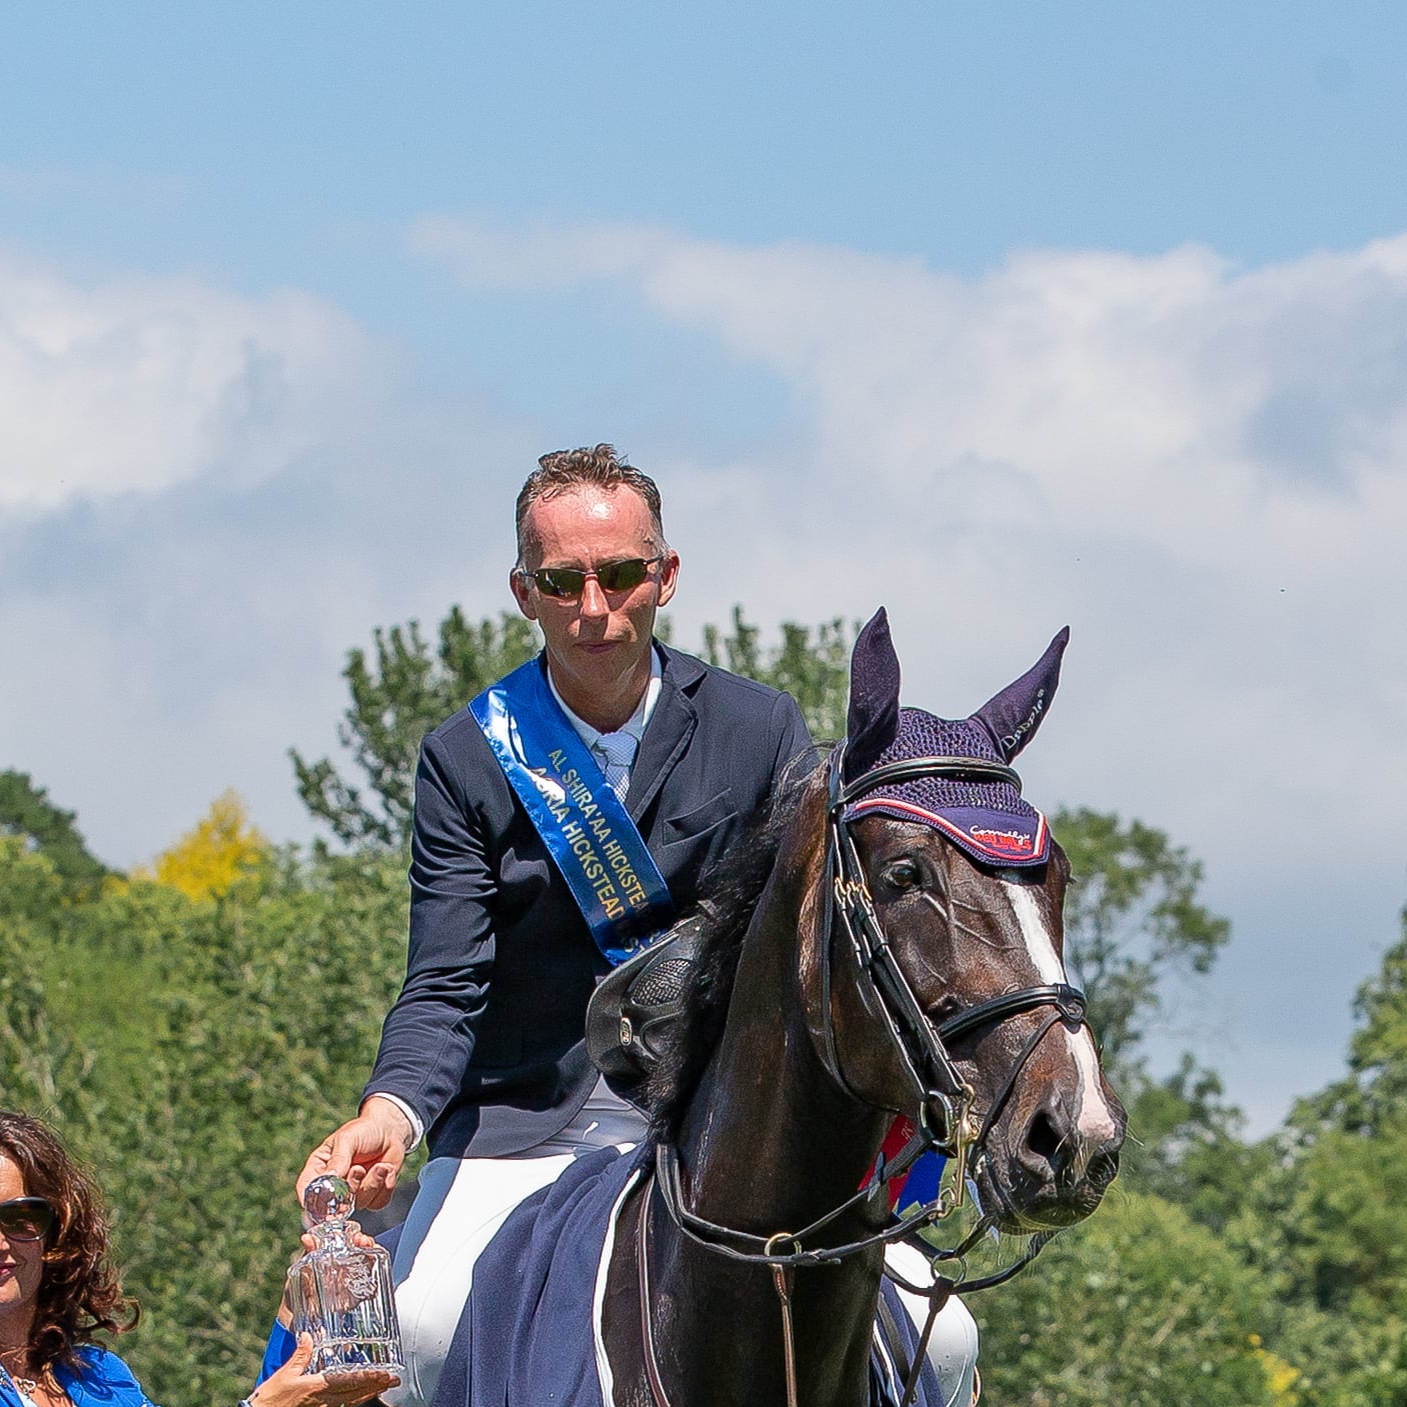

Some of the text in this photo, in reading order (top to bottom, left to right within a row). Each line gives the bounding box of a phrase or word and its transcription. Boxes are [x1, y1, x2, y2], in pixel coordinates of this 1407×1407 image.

[548, 749, 567, 773] AL
[561, 769, 612, 843] SHIRA'AA
[602, 839, 651, 913] HICKSTEA
[561, 820, 625, 920] HICKSTEAD
